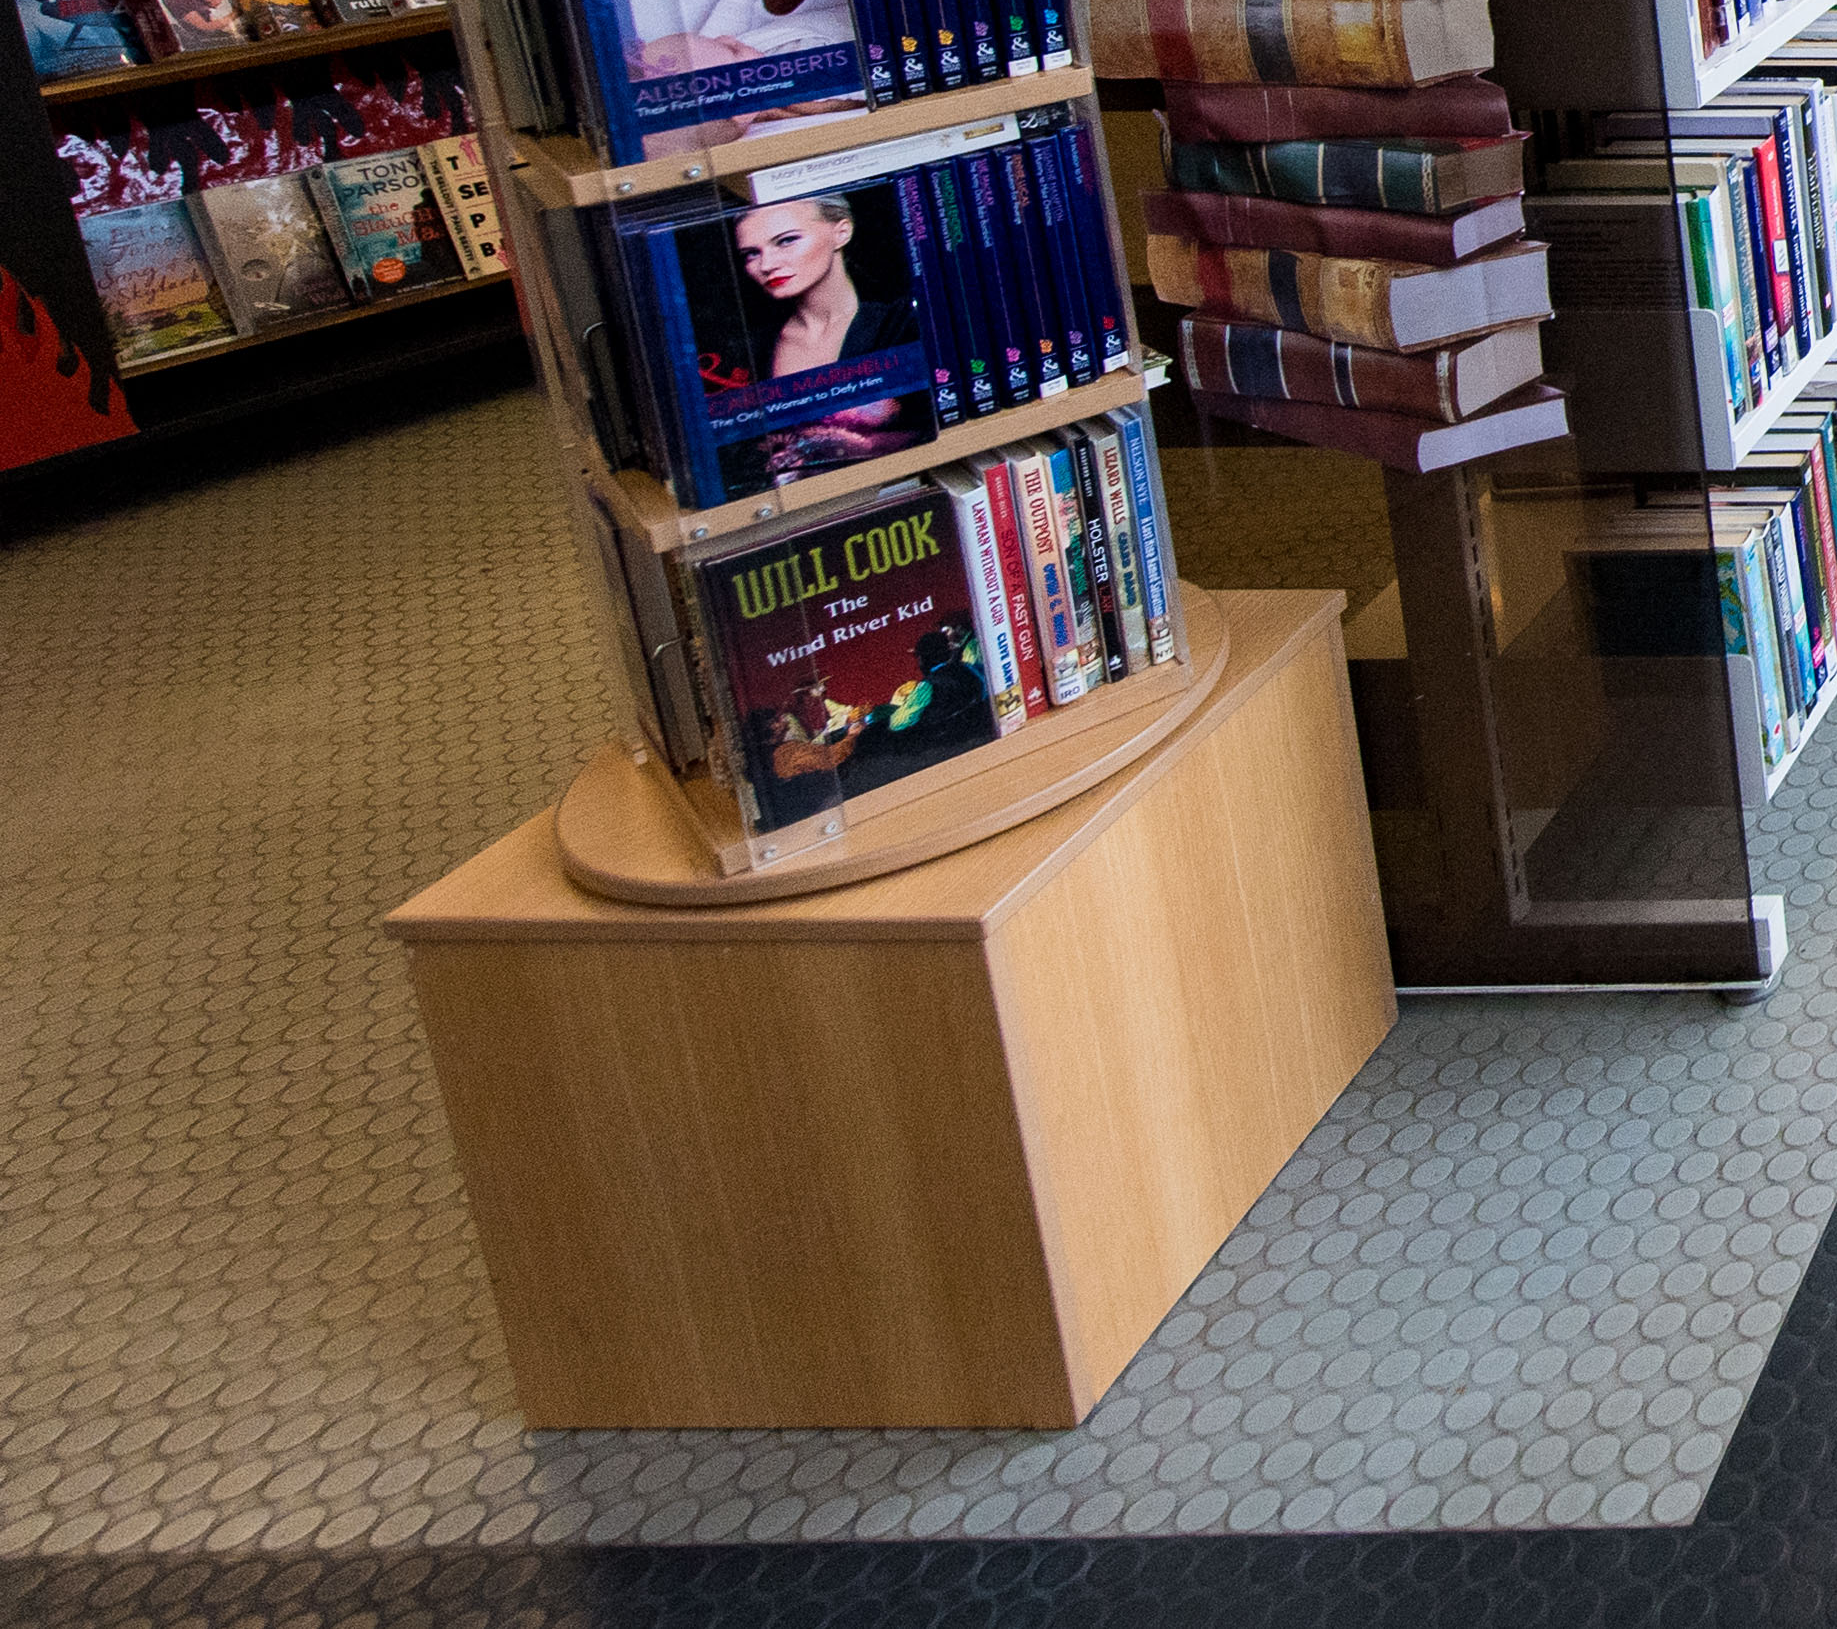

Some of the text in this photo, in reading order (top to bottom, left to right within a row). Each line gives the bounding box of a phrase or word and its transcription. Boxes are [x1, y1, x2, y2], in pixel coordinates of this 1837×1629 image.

[634, 48, 849, 103] ALISON ROBERTS
[634, 79, 794, 117] Their First Family Christmas
[357, 159, 421, 181] TONY
[1781, 138, 1791, 163] LIZ
[369, 200, 399, 215] the
[906, 175, 927, 240] SUSAN CARLISLE
[1783, 164, 1799, 228] FENWICK
[1791, 234, 1802, 265] Under
[706, 354, 900, 417] CAROL MARINELLI
[710, 416, 735, 430] The
[763, 393, 813, 414] Woman
[814, 390, 828, 401] to
[829, 382, 858, 399] Defy
[858, 374, 883, 388] Him
[1101, 447, 1122, 487] LIZARD
[1126, 436, 1146, 482] NELSON
[1023, 468, 1054, 555] THE OUTPOST
[1108, 489, 1127, 525] WELLS
[1134, 483, 1150, 505] NYE
[730, 509, 944, 621] WILL COOK
[970, 500, 1010, 660] LAWMAN WITHOUT A GUN CLIVE
[1086, 518, 1114, 614] HOLSTER LAW
[821, 592, 871, 619] The
[1000, 529, 1035, 661] SON OF A FAST GUN
[767, 594, 935, 668] Wind River Kid
